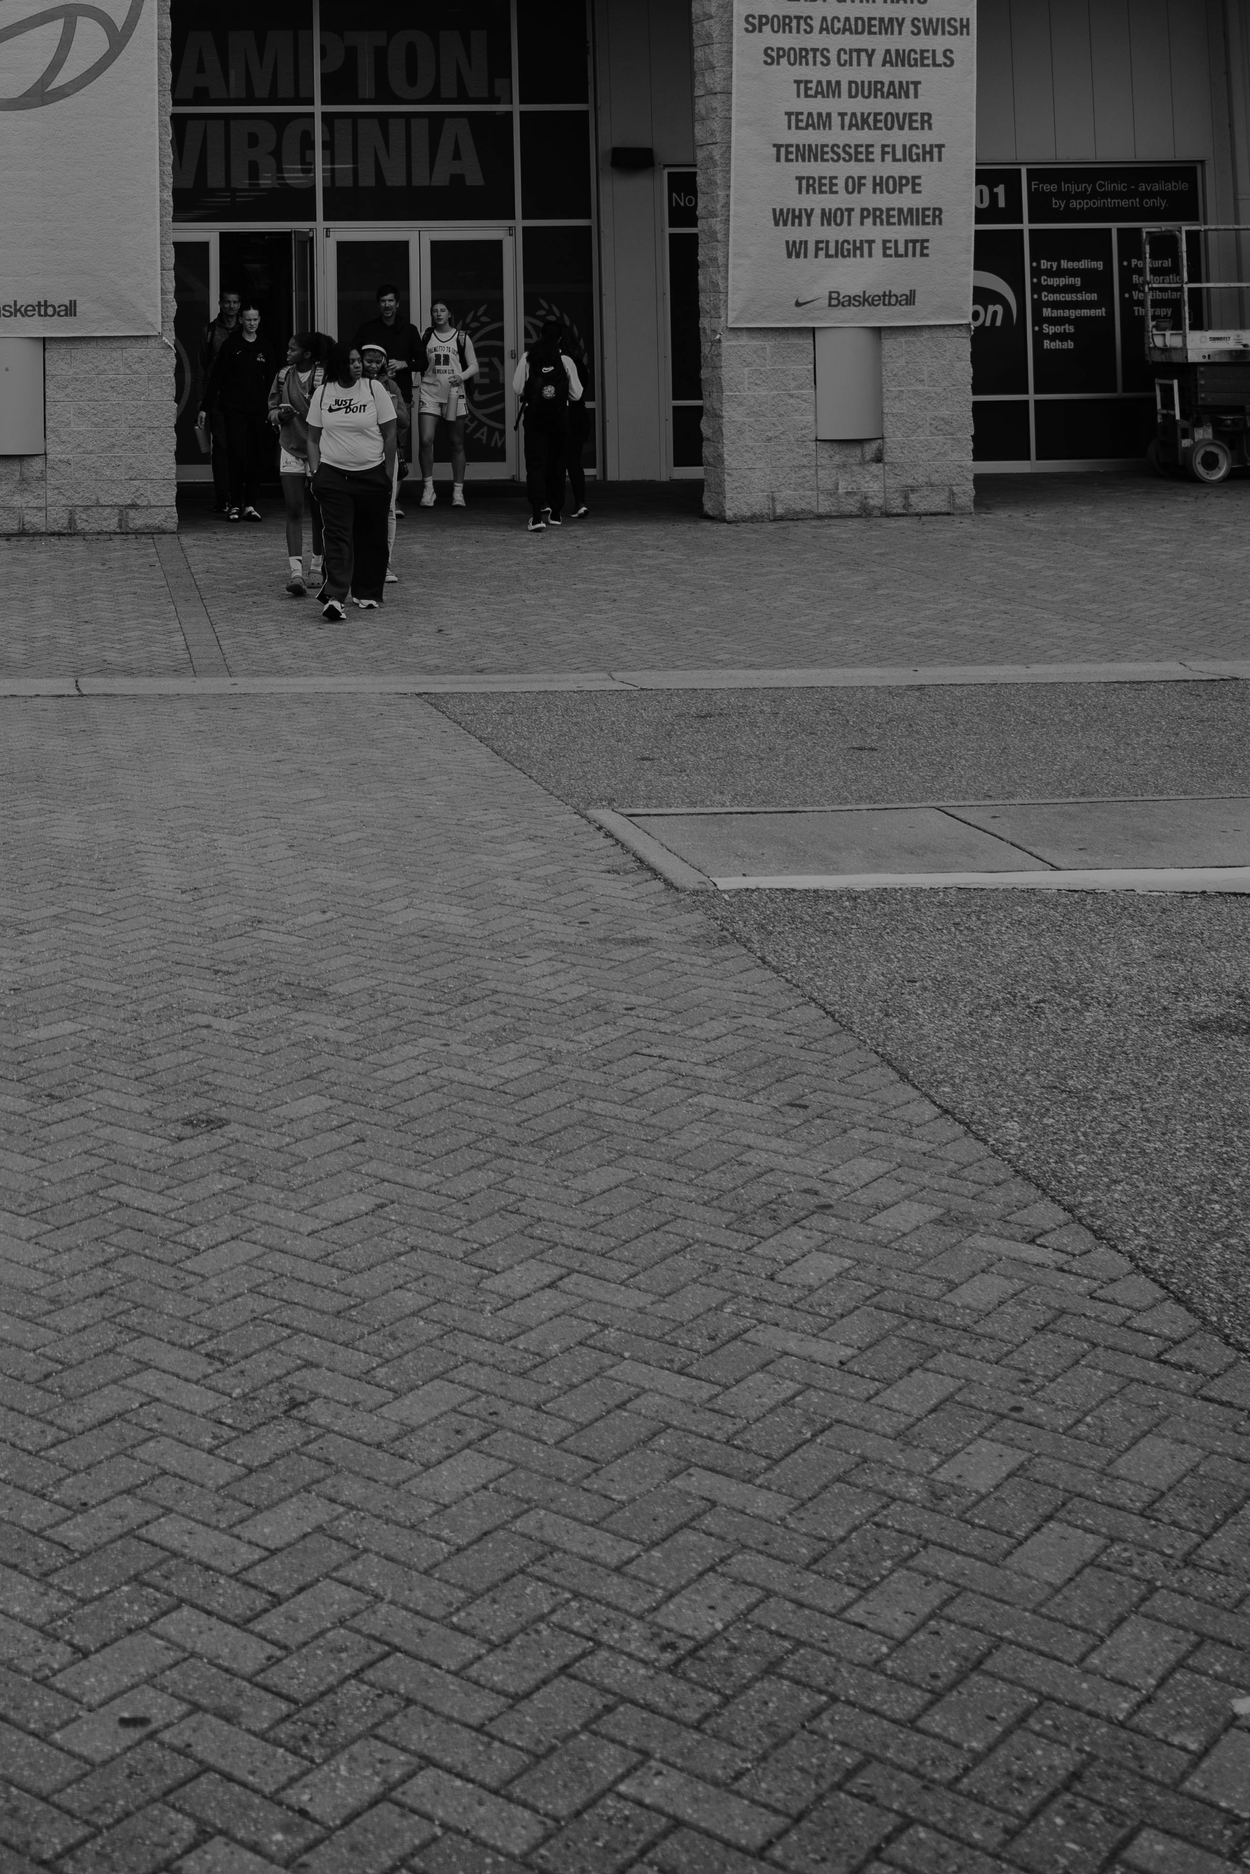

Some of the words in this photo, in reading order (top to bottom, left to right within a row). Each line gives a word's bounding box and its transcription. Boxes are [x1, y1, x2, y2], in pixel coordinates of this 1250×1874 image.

[744, 14, 813, 34] SPORTS
[819, 16, 905, 35] ACADEMY
[911, 17, 969, 36] SWISH
[763, 47, 830, 66] SPORTS
[837, 48, 876, 67] CITY
[881, 49, 954, 67] ANGELS
[794, 80, 841, 98] TEAM
[848, 80, 921, 99] DURANT
[785, 112, 831, 130] TEAM
[838, 112, 932, 131] TAKEOVER
[172, 118, 485, 188] VIRGINIA
[773, 144, 874, 162] TENNESSEE
[881, 144, 945, 162] FLIGHT
[795, 176, 838, 194] TREE
[845, 176, 866, 194] OF
[873, 176, 922, 194] HOPE
[1032, 182, 1057, 192] Free
[1062, 182, 1092, 194] Injury
[1096, 181, 1127, 191] Clinic
[1139, 181, 1188, 191] available
[1053, 198, 1065, 210] by
[1070, 198, 1139, 209] appointment
[1143, 197, 1169, 209] only.
[772, 208, 814, 227] WHY
[821, 208, 854, 226] NOT
[860, 207, 943, 226] PREMIER
[785, 240, 808, 259] WI
[814, 240, 875, 258] FLIGHT
[882, 239, 929, 258] ELITE
[1041, 260, 1057, 270] Dry
[1061, 260, 1103, 270] Needling
[1131, 258, 1171, 268] Potural
[1041, 276, 1080, 286] Cupping
[828, 289, 916, 307] Basketball
[1042, 292, 1097, 301] Concussion
[1132, 290, 1181, 300] Vetibular
[1043, 308, 1105, 318] Management
[1133, 307, 1172, 317] Thrapy
[1043, 324, 1074, 335] Sports
[1044, 340, 1073, 349] Rehab
[334, 398, 354, 406] JUST
